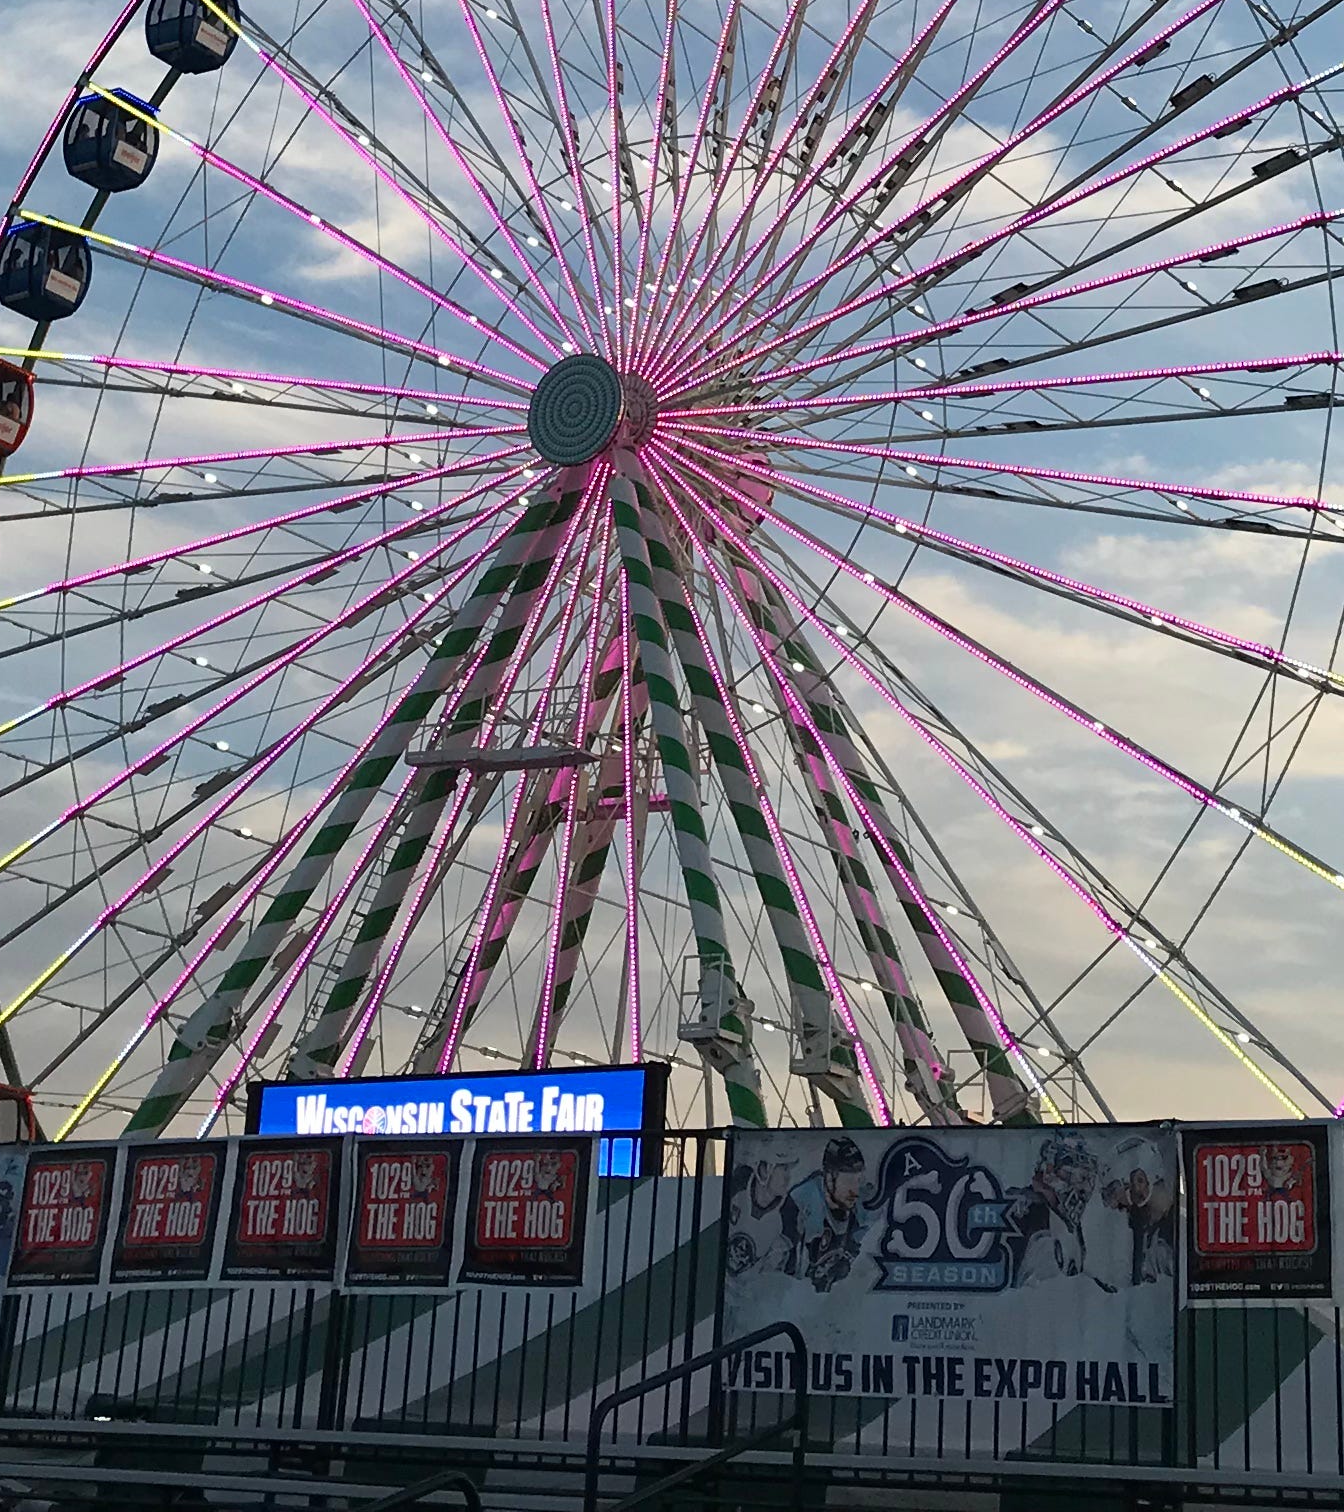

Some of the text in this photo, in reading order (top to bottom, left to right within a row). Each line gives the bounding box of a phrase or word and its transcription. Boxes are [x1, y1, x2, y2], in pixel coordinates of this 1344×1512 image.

[33, 1170, 71, 1205] 1029
[139, 1164, 179, 1200] 1029
[251, 1160, 293, 1196] 1029
[370, 1162, 411, 1199] 1029
[488, 1160, 534, 1197] 1029
[1203, 1154, 1263, 1197] 1029
[28, 1207, 94, 1242] THE HOG
[132, 1202, 202, 1238] THE HOG
[246, 1199, 318, 1235] THE HOG
[367, 1203, 439, 1240] THE HOG
[484, 1200, 564, 1239] THE HOG
[1203, 1200, 1305, 1244] THE HOG
[892, 1266, 997, 1284] SEASON
[911, 1316, 976, 1329] LANDMARK
[812, 1353, 852, 1391] US
[862, 1355, 893, 1393] IN
[903, 1356, 964, 1396] THE
[974, 1358, 1067, 1399] EXPO
[1076, 1361, 1168, 1403] HALL
